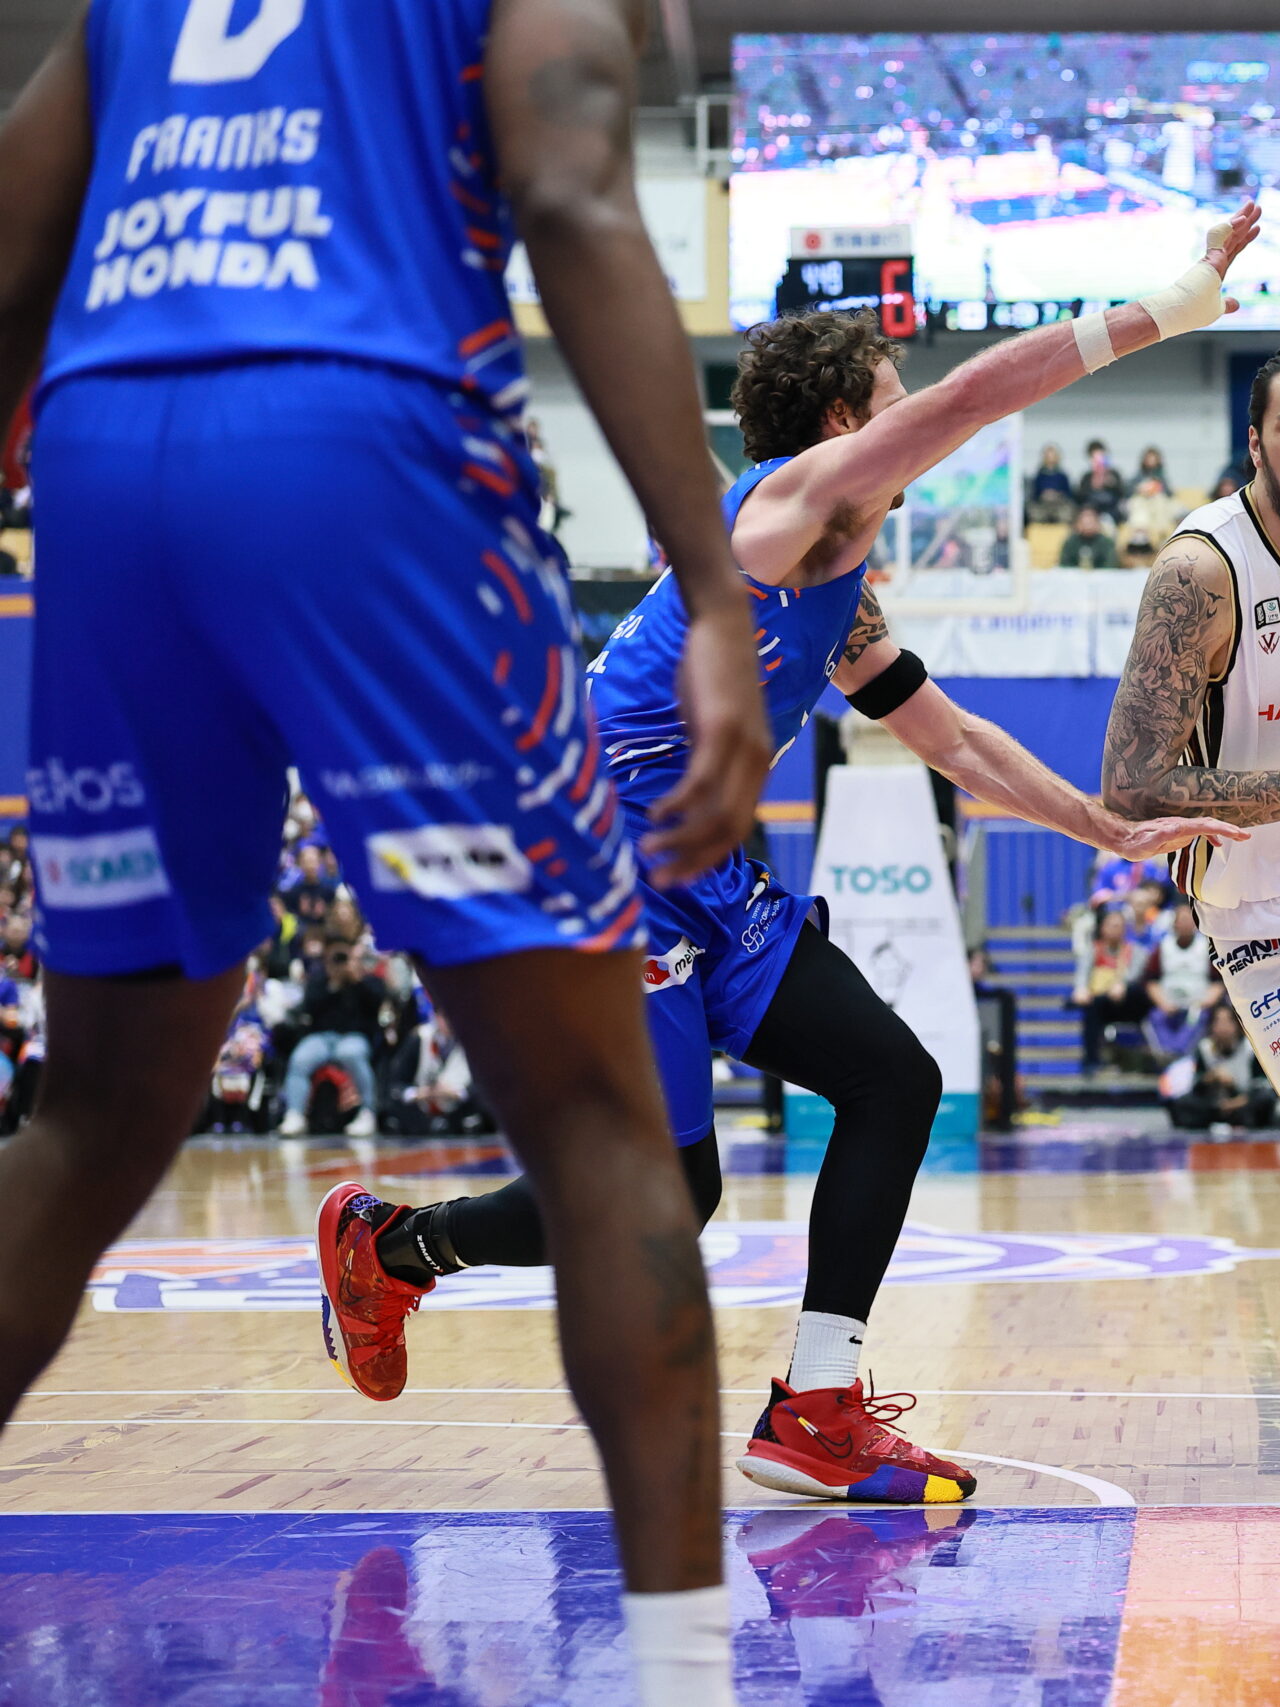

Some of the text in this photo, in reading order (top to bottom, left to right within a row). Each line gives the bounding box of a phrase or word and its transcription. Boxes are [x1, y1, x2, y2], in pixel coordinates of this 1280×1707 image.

[126, 107, 322, 183] FRANKS
[94, 187, 332, 260] JOYFUL
[84, 240, 319, 311] HONDA
[829, 865, 931, 895] TOSO
